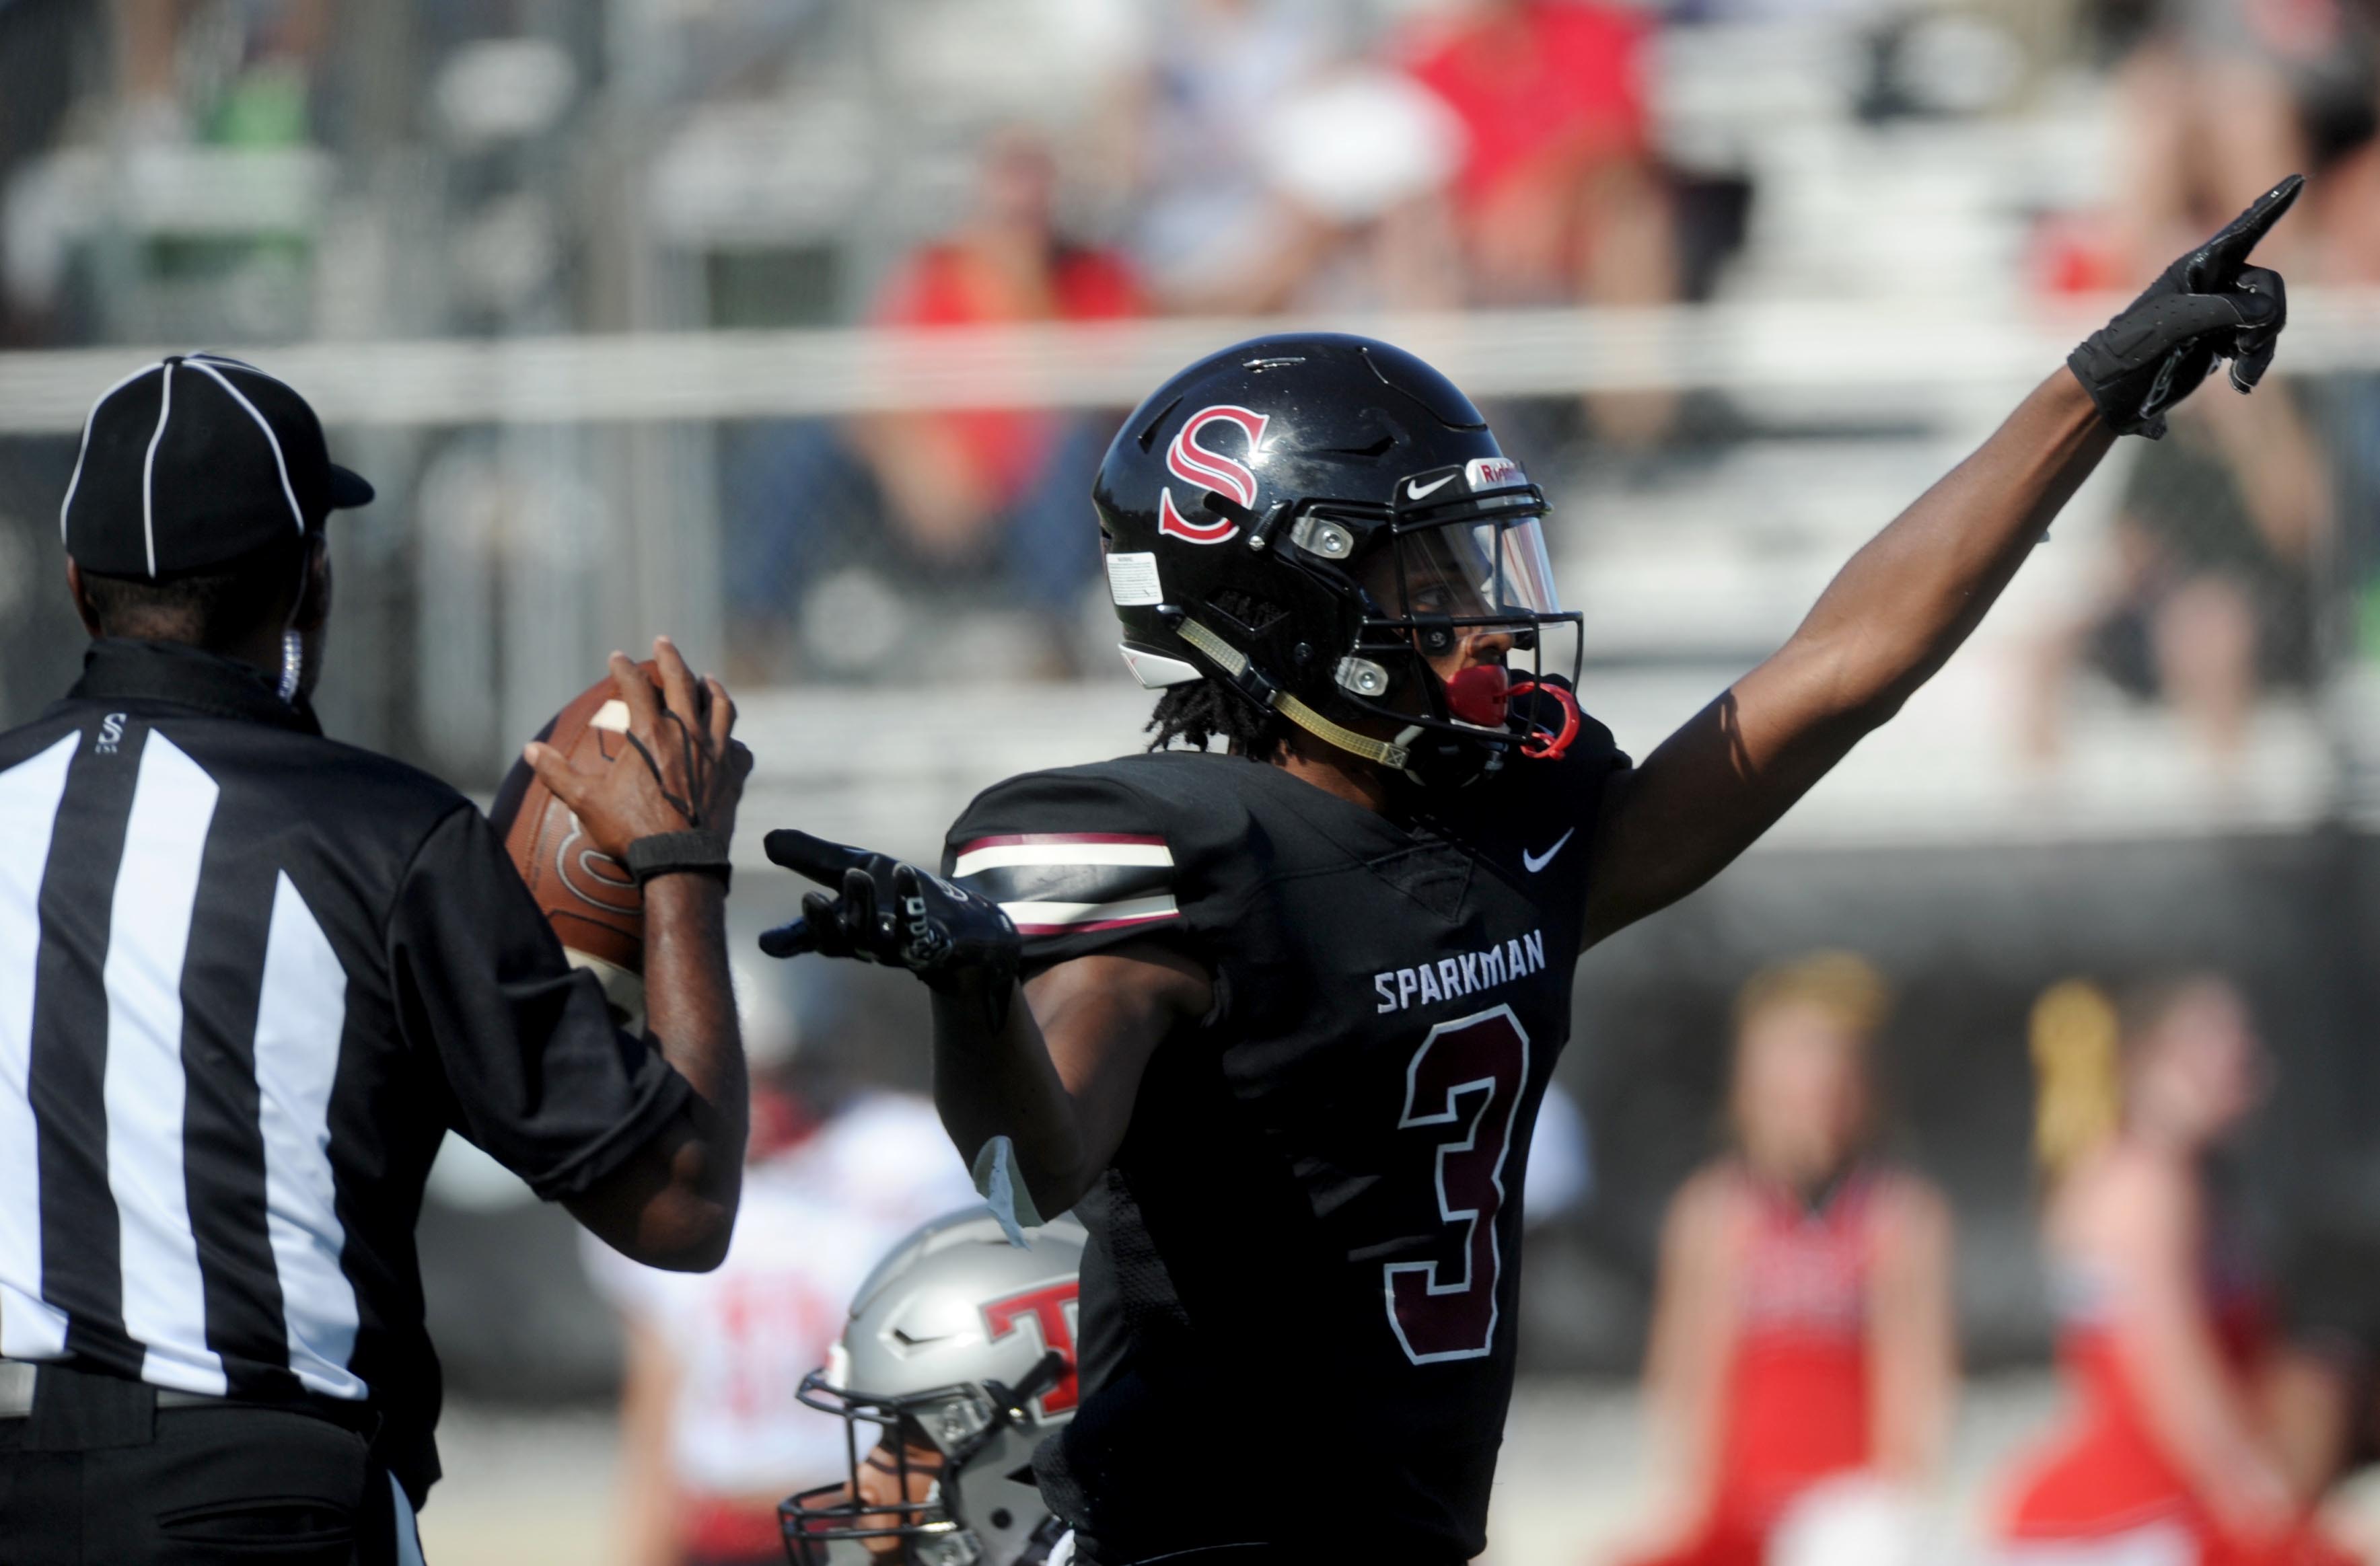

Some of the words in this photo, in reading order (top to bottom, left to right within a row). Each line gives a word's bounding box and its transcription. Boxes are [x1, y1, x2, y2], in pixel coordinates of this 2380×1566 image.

[1159, 406, 1270, 544] S
[1375, 929, 1545, 1013] SPARKMAN
[1383, 1003, 1529, 1366] 3
[978, 1271, 1080, 1427] T
